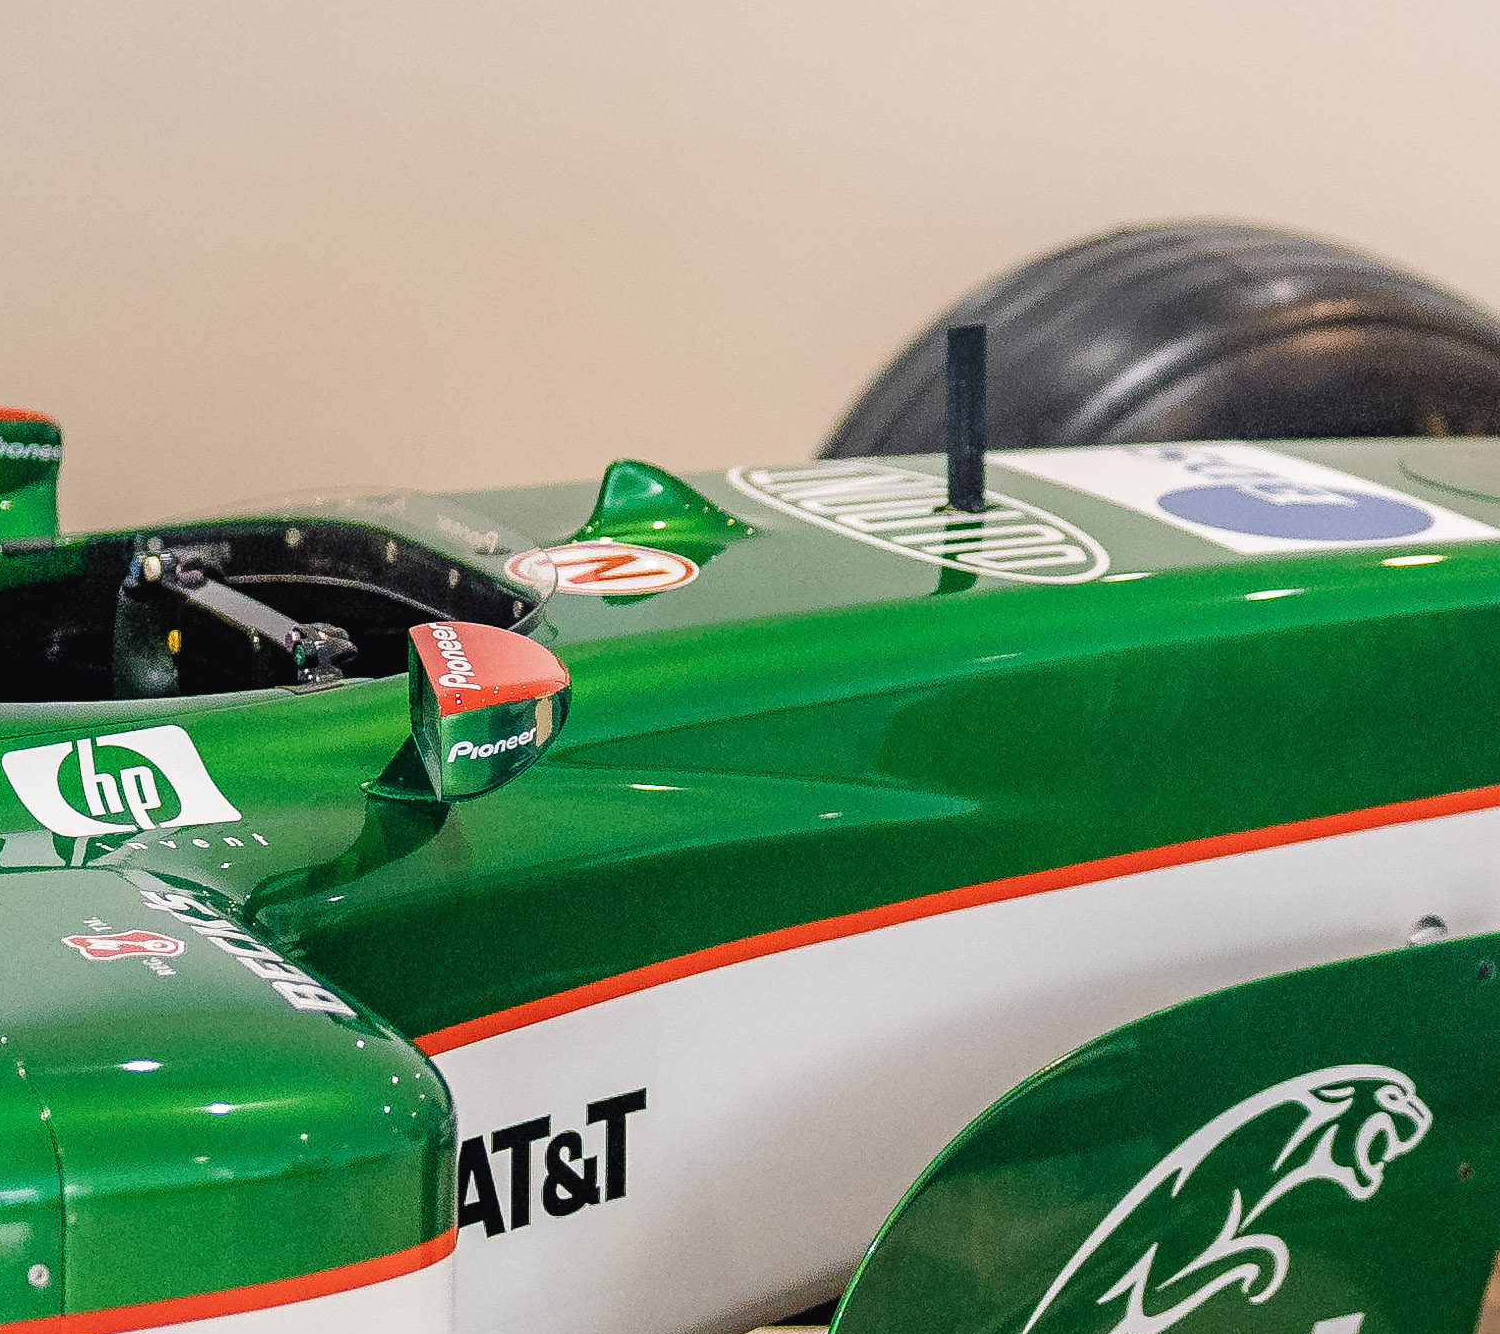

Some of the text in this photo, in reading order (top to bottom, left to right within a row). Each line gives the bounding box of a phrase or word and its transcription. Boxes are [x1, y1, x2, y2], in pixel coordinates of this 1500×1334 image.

[428, 622, 482, 691] Pioneer
[446, 727, 537, 763] Pioneer
[76, 737, 162, 830] hp
[95, 832, 269, 851] invent
[457, 1086, 648, 1240] AT&T
